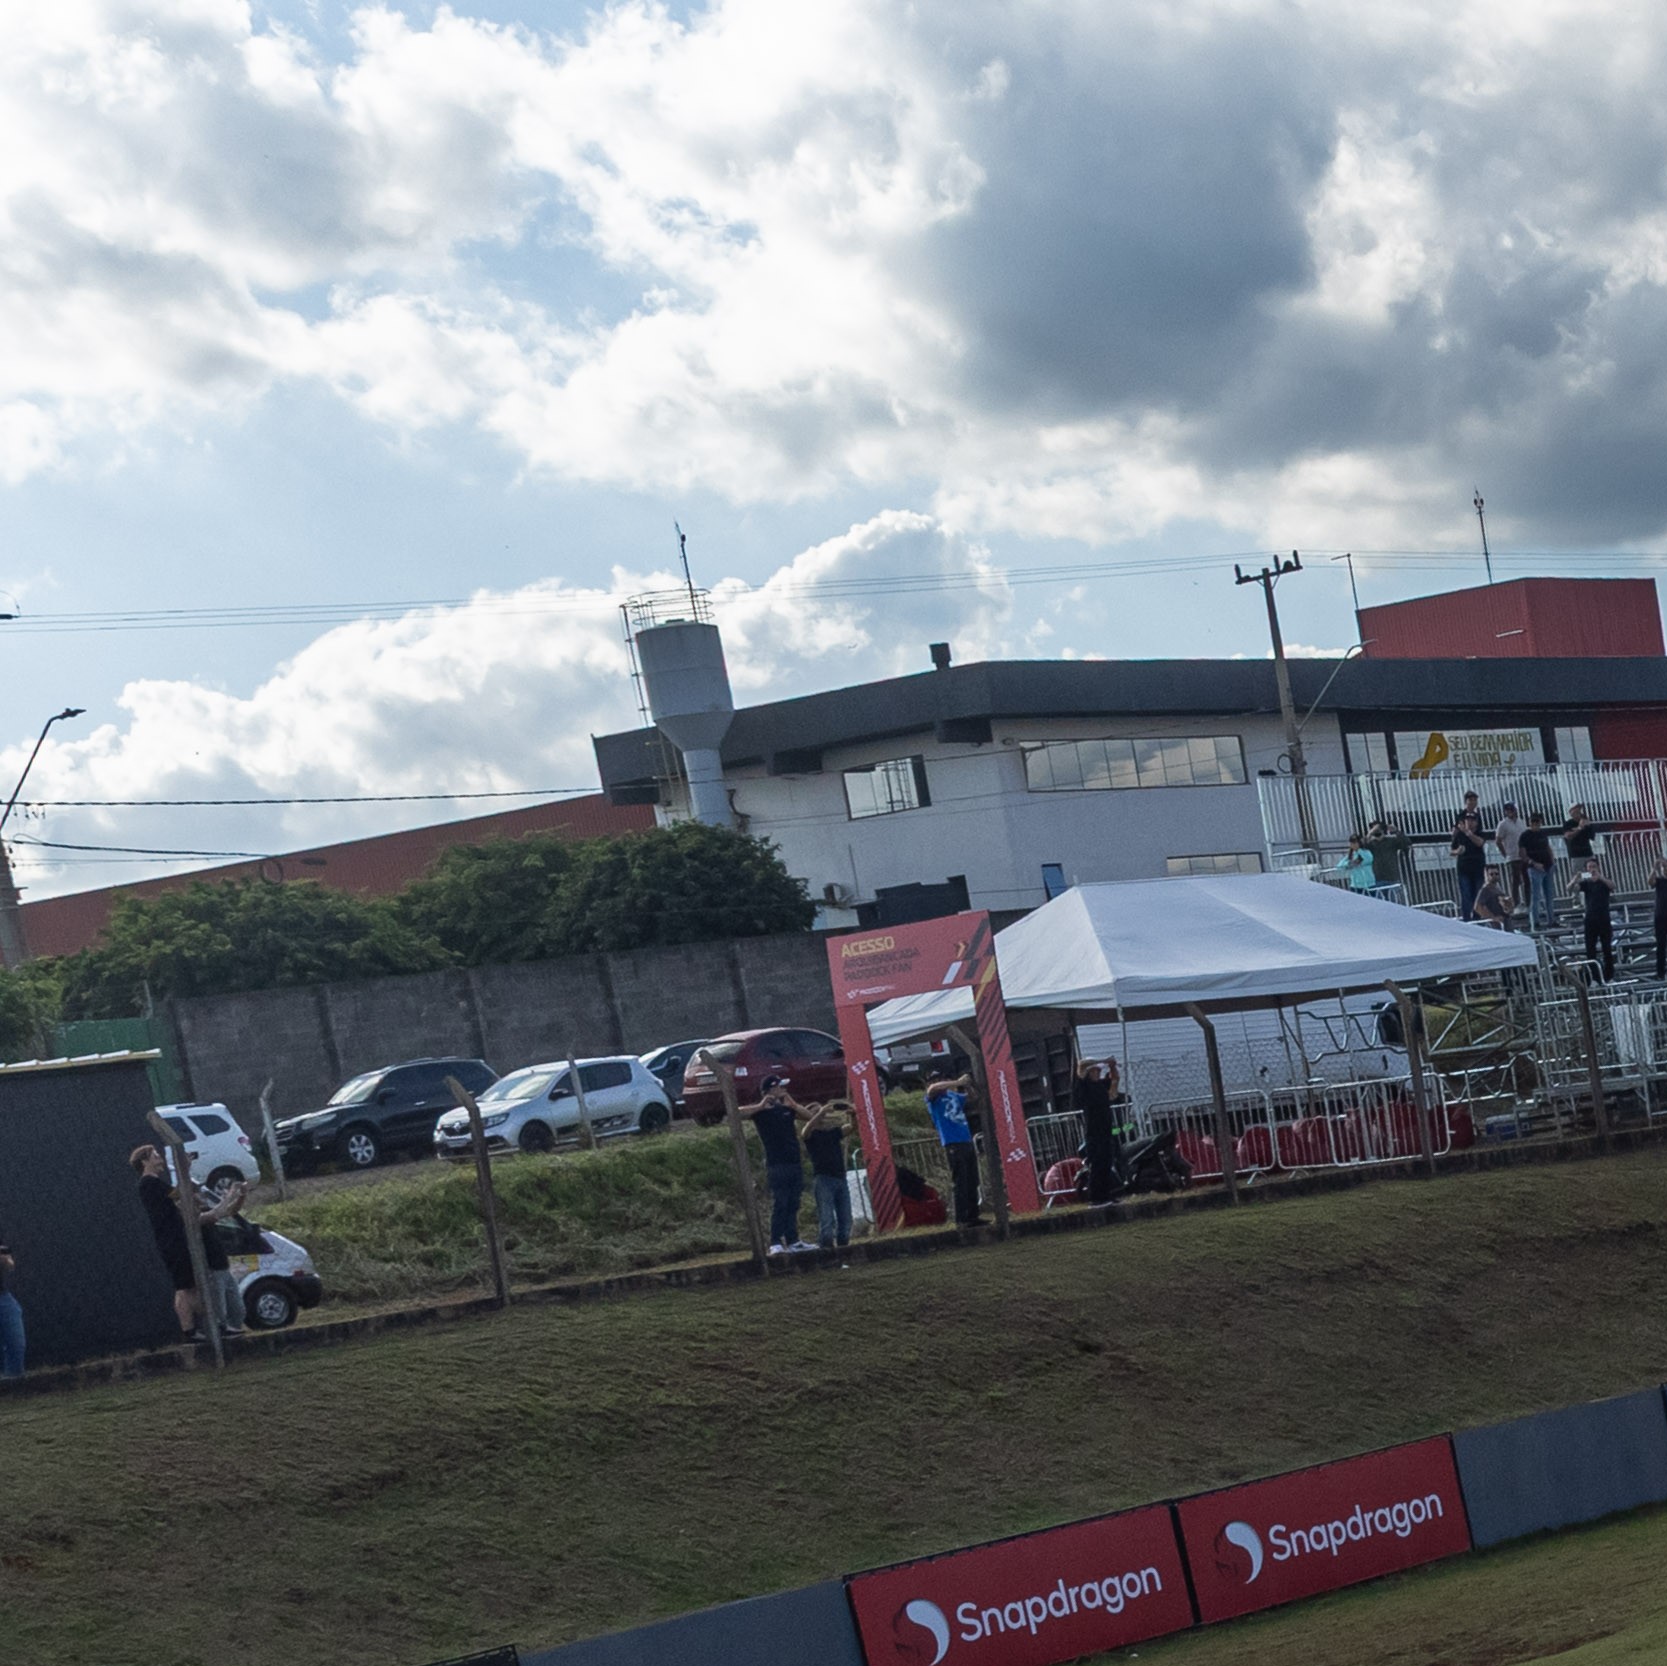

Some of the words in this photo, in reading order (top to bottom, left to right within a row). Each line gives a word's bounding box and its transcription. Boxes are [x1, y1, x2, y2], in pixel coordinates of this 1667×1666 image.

[841, 936, 895, 957] ACESSO
[1268, 1492, 1444, 1562] Snapdragon
[956, 1564, 1162, 1643] Snapdragon
